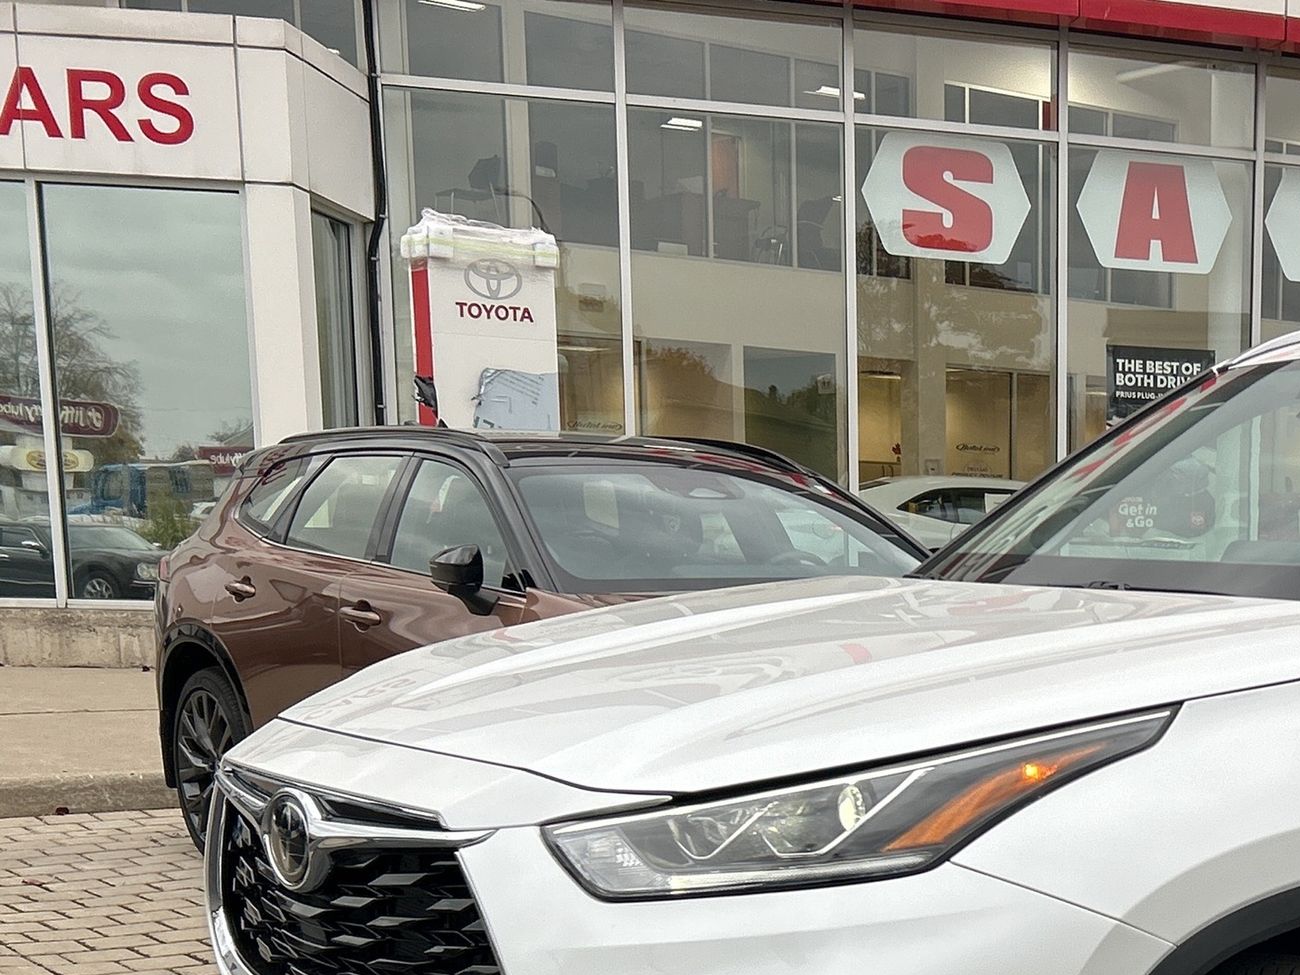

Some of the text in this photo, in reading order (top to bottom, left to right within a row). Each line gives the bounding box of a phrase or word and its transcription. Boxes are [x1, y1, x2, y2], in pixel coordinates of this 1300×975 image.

[0, 66, 194, 145] ARS
[455, 302, 534, 323] TOYOTA
[1116, 359, 1202, 376] THE BEST OF
[1116, 373, 1191, 389] BOTH DRIV
[1116, 391, 1136, 399] PRIUS
[1119, 503, 1158, 515] Get in
